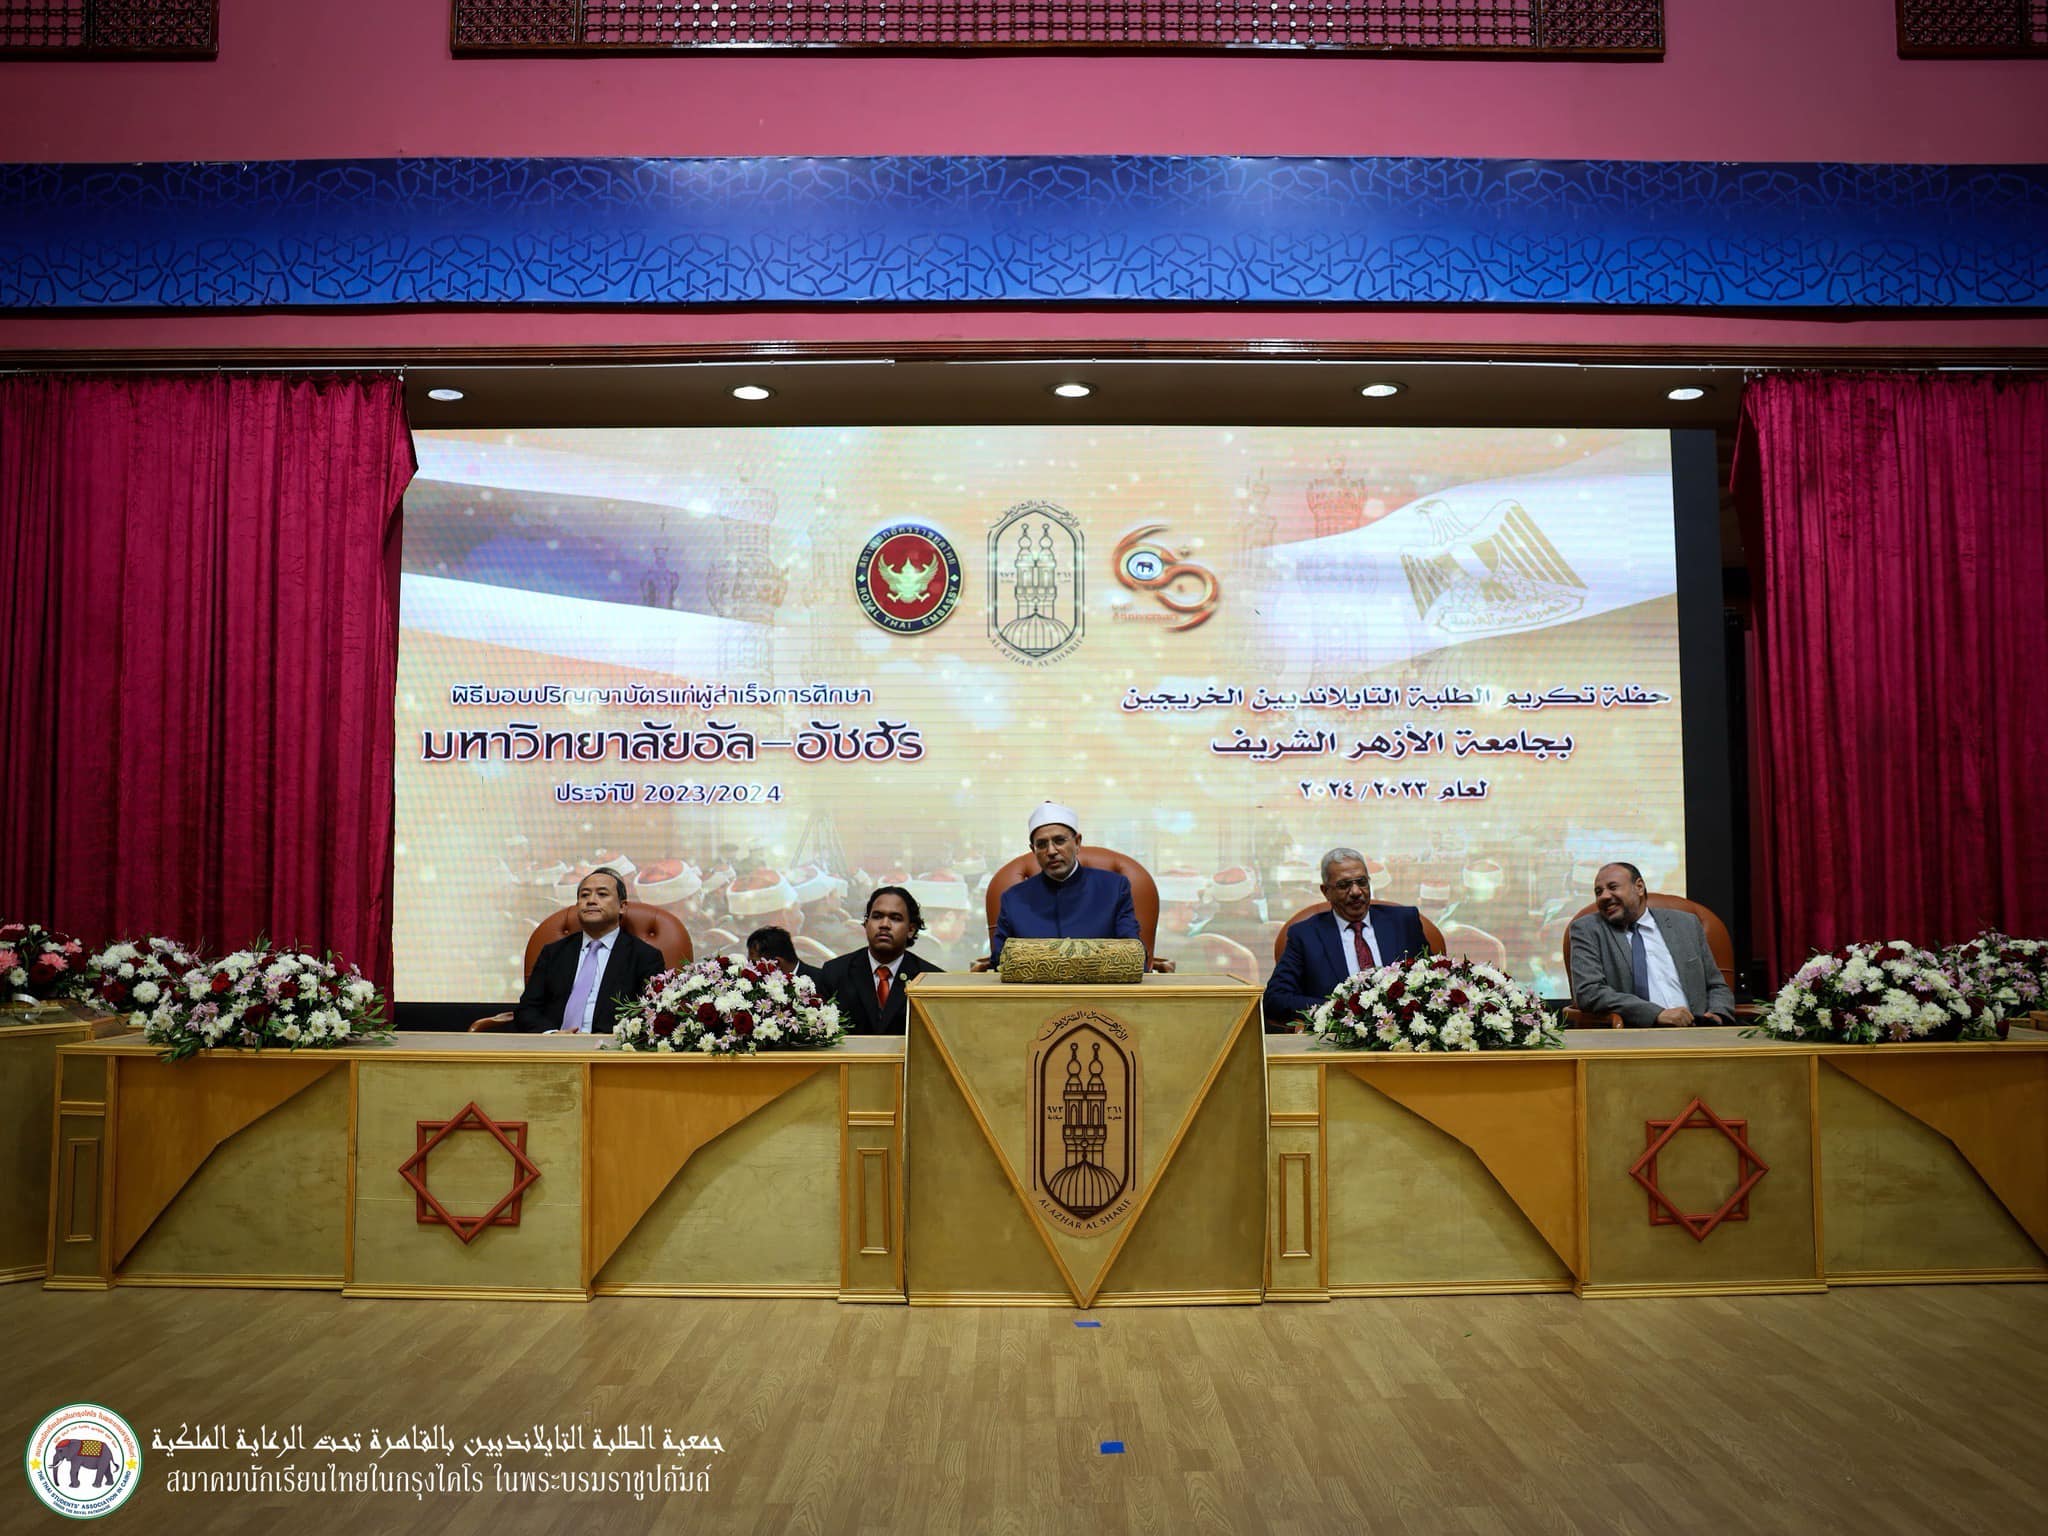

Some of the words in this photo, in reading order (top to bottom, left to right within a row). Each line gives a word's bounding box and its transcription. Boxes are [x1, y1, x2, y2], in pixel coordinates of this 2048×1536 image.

[859, 587, 881, 618] ROYAL
[883, 617, 912, 629] THAI
[921, 586, 958, 626] EMBASSY
[451, 684, 872, 709] พิธีมอบปริญญาบัตรแก่ผู้สำเร็จการศึกษา
[1122, 686, 1244, 710] الخريجين
[1252, 686, 1400, 710] التايلانديين
[1407, 686, 1491, 711] الطلبة
[1502, 685, 1596, 709] تكريم
[1602, 685, 1671, 708] حفلة
[1212, 729, 1336, 759] الشريف
[1347, 724, 1444, 759] الأزهر
[1455, 729, 1574, 759] بجامعة
[556, 783, 634, 802] ประจำปี
[644, 784, 781, 804] 2023/2024
[1437, 780, 1489, 799] لعام
[1039, 1199, 1049, 1209] AL
[1048, 1209, 1081, 1229] AZHAR
[1100, 1198, 1133, 1225] SHARIF
